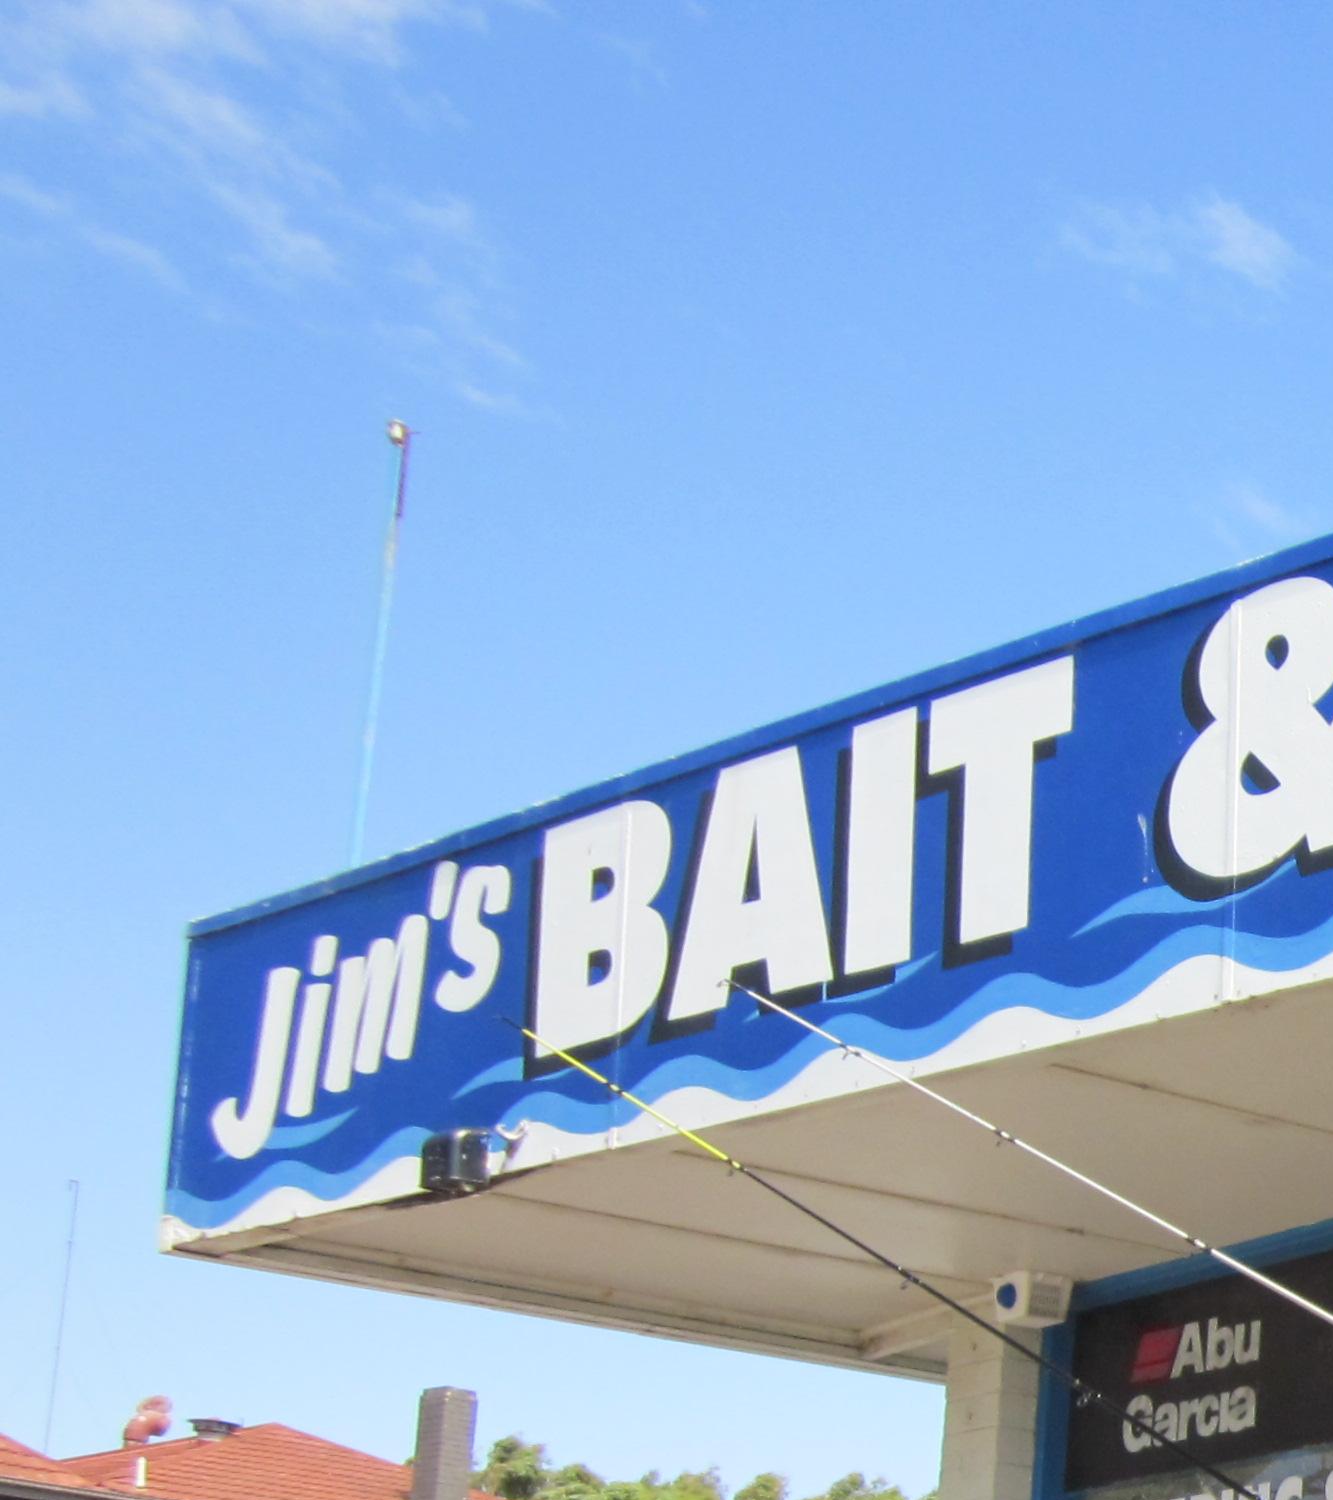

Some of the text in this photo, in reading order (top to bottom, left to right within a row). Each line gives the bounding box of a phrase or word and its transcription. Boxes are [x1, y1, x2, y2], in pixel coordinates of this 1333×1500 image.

[212, 859, 512, 1160] Jim's
[530, 655, 1075, 1062] BAIT
[1169, 1317, 1261, 1379] Abu
[1122, 1385, 1257, 1453] Garcia
